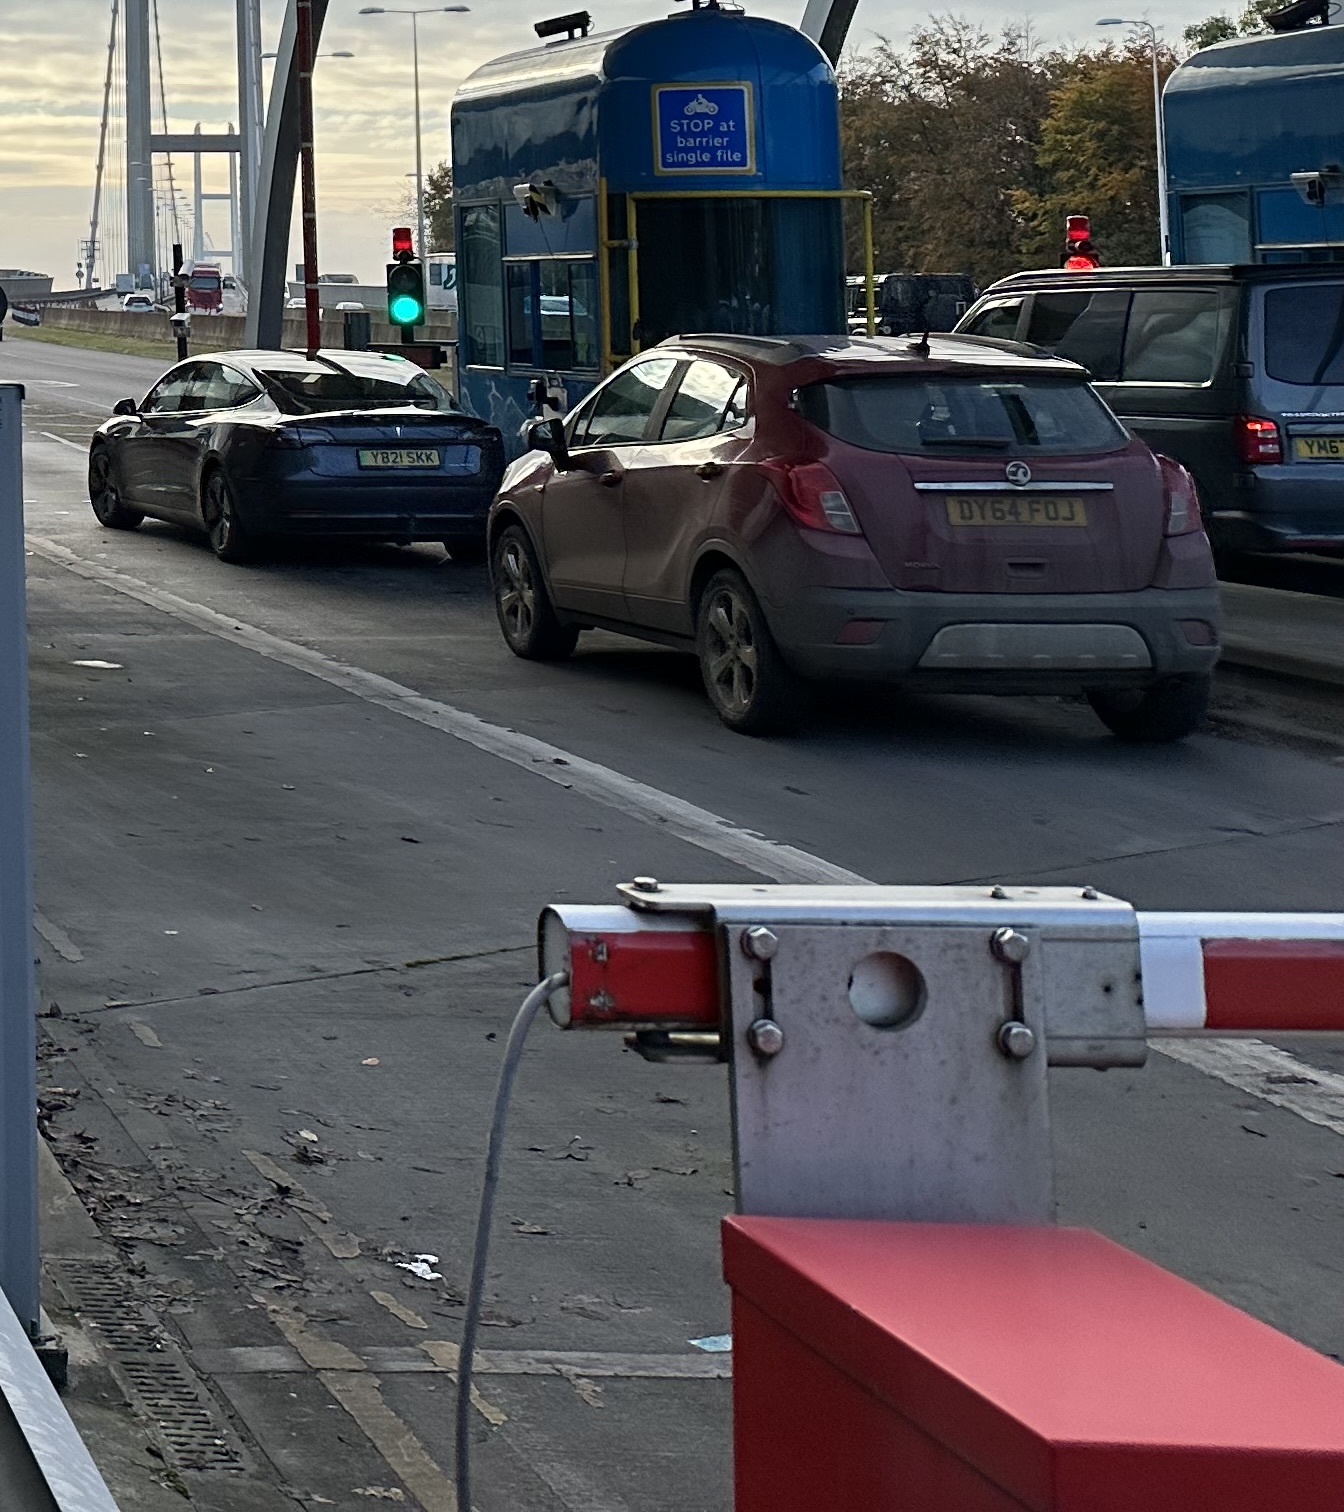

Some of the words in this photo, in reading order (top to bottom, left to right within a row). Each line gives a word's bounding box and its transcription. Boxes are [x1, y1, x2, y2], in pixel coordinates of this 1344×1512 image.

[670, 119, 714, 133] STOP
[719, 119, 736, 131] at
[677, 135, 730, 147] barrier
[666, 149, 711, 164] single
[716, 149, 742, 161] file
[371, 451, 404, 464] YB21
[406, 451, 435, 464] SKK
[958, 498, 1022, 522] DY64
[1028, 499, 1076, 522] FOJ
